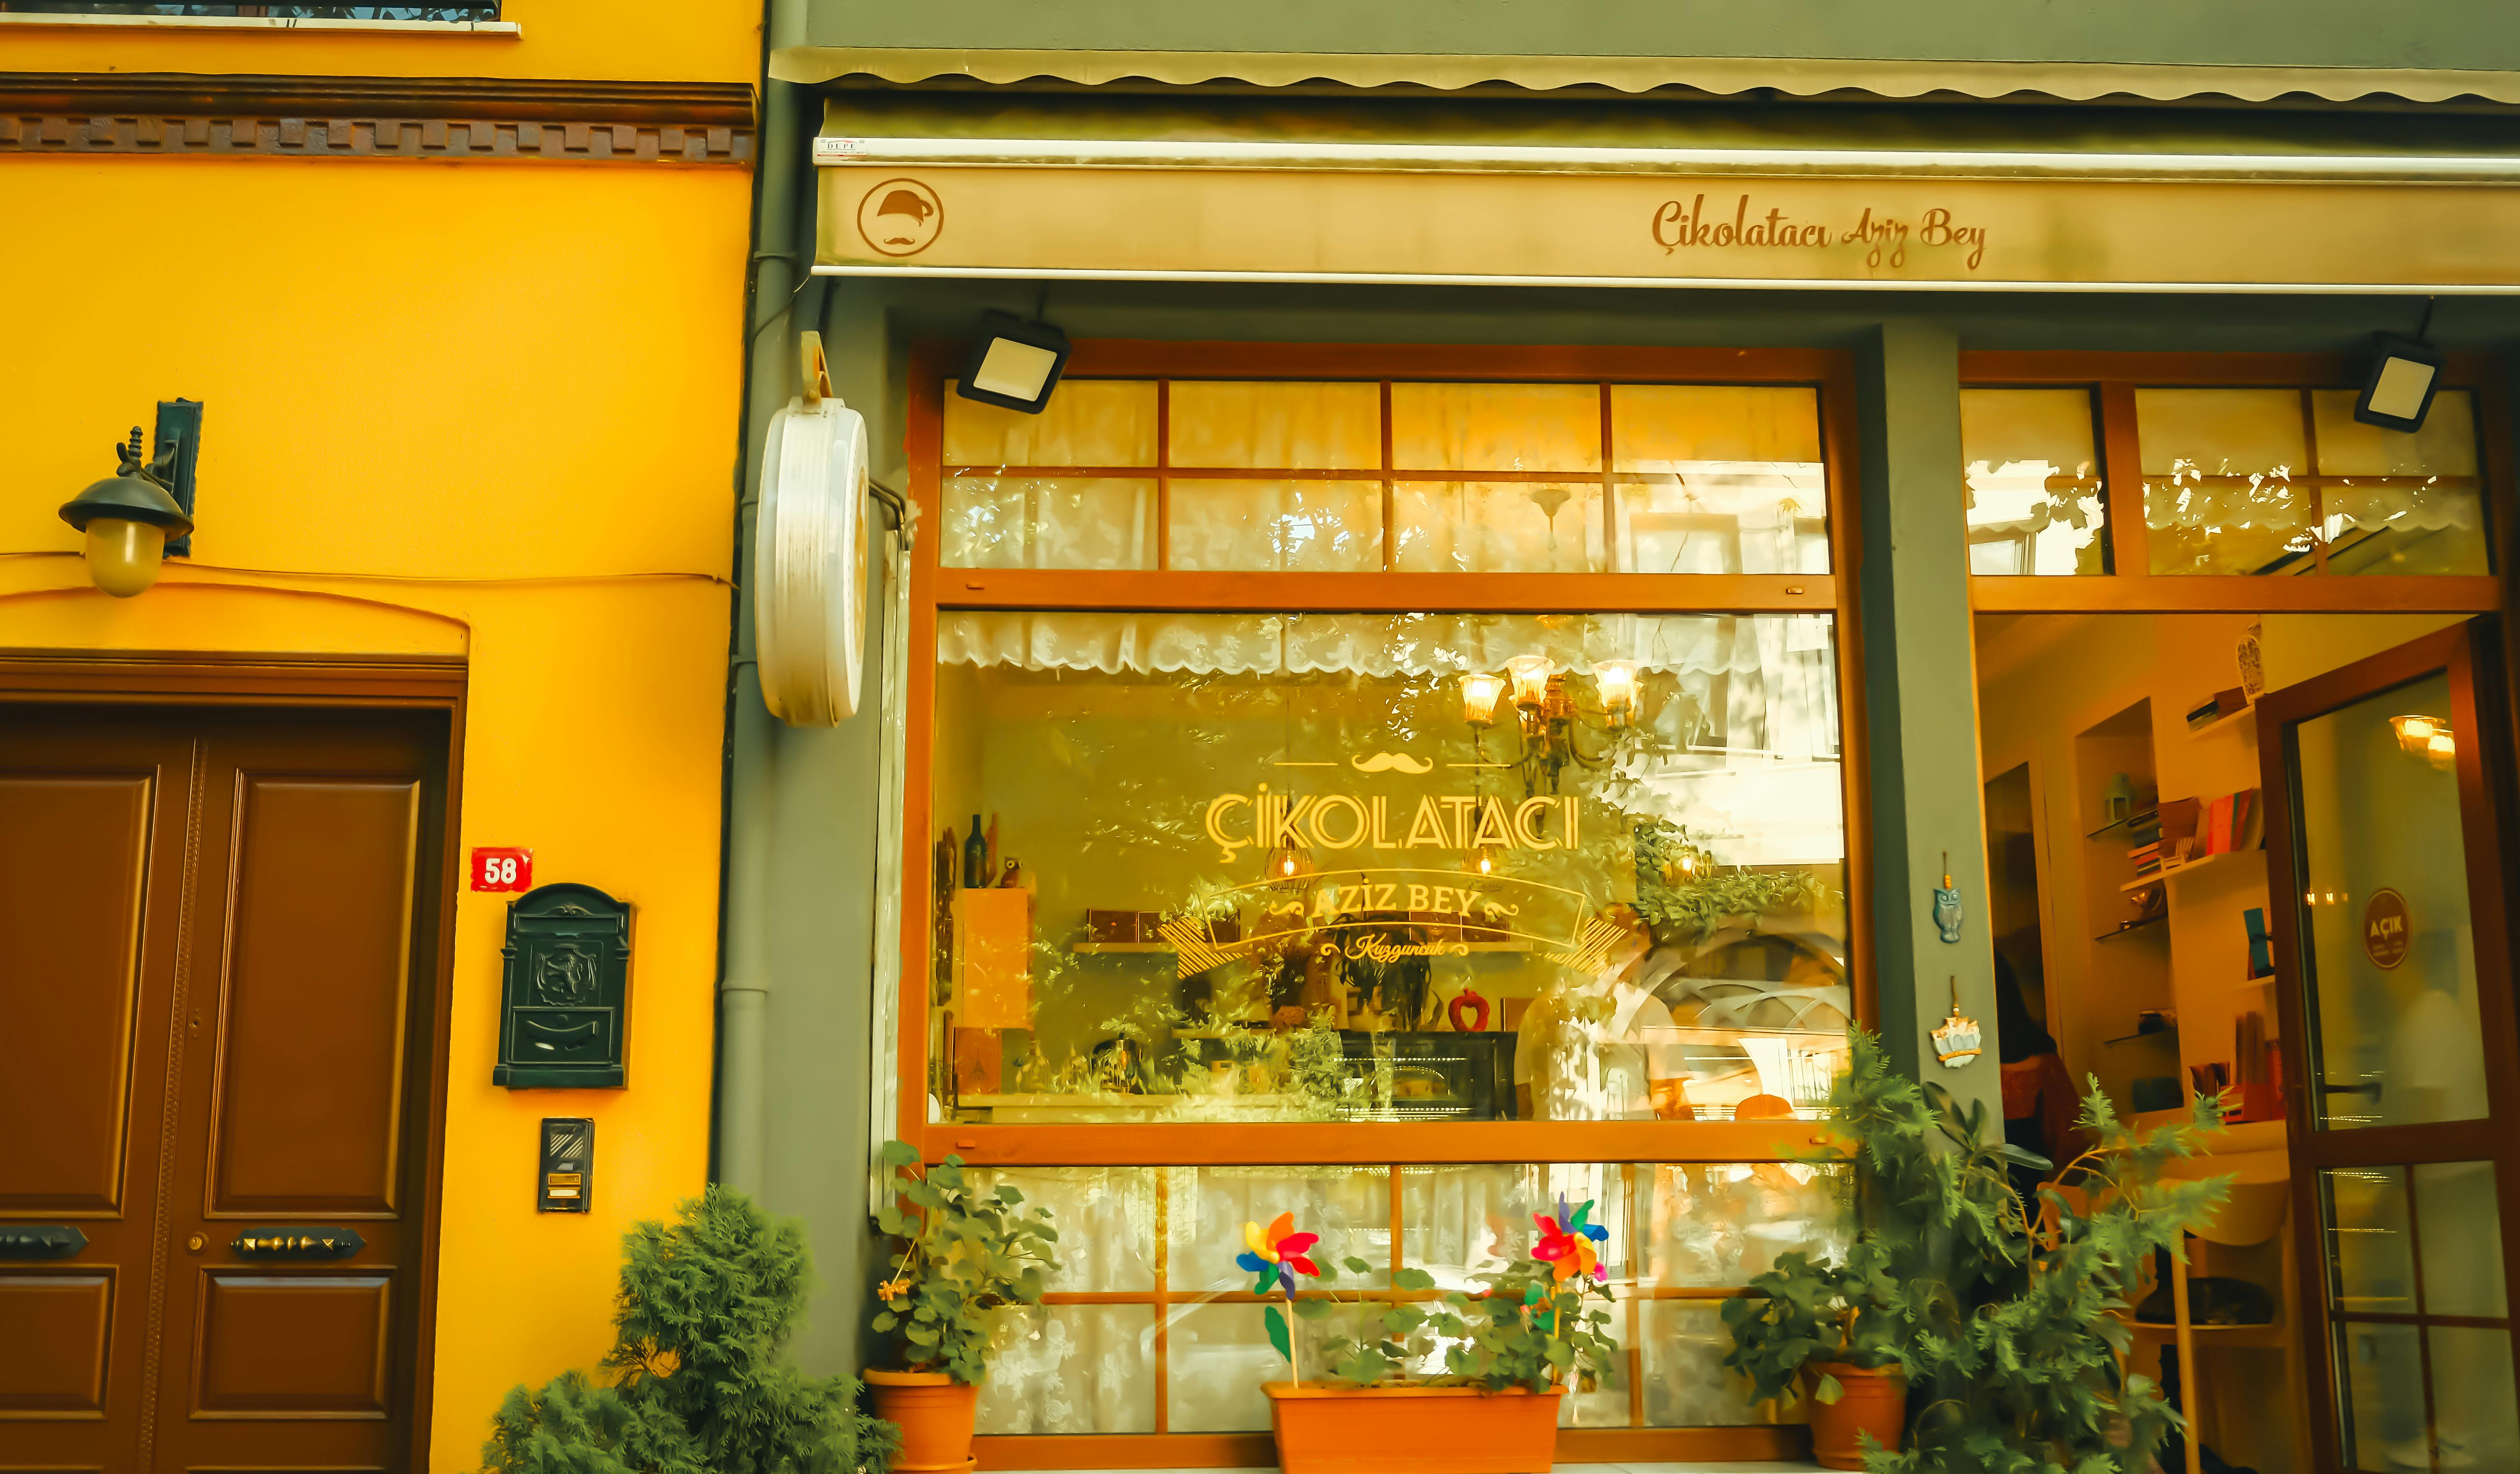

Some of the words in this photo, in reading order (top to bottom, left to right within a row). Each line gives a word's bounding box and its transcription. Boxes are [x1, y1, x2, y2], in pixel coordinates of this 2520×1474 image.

[1652, 194, 1832, 255] Çikolatacı
[1841, 208, 1909, 268] Aziz
[1920, 208, 1986, 270] Bey
[1205, 783, 1579, 863] ÇİKOLATACI
[485, 858, 516, 884] 58
[1312, 878, 1397, 917] AZİZ
[1407, 884, 1481, 917] BEY
[2370, 915, 2403, 940] AÇIK
[1344, 933, 1445, 963] Kuzguncuk
